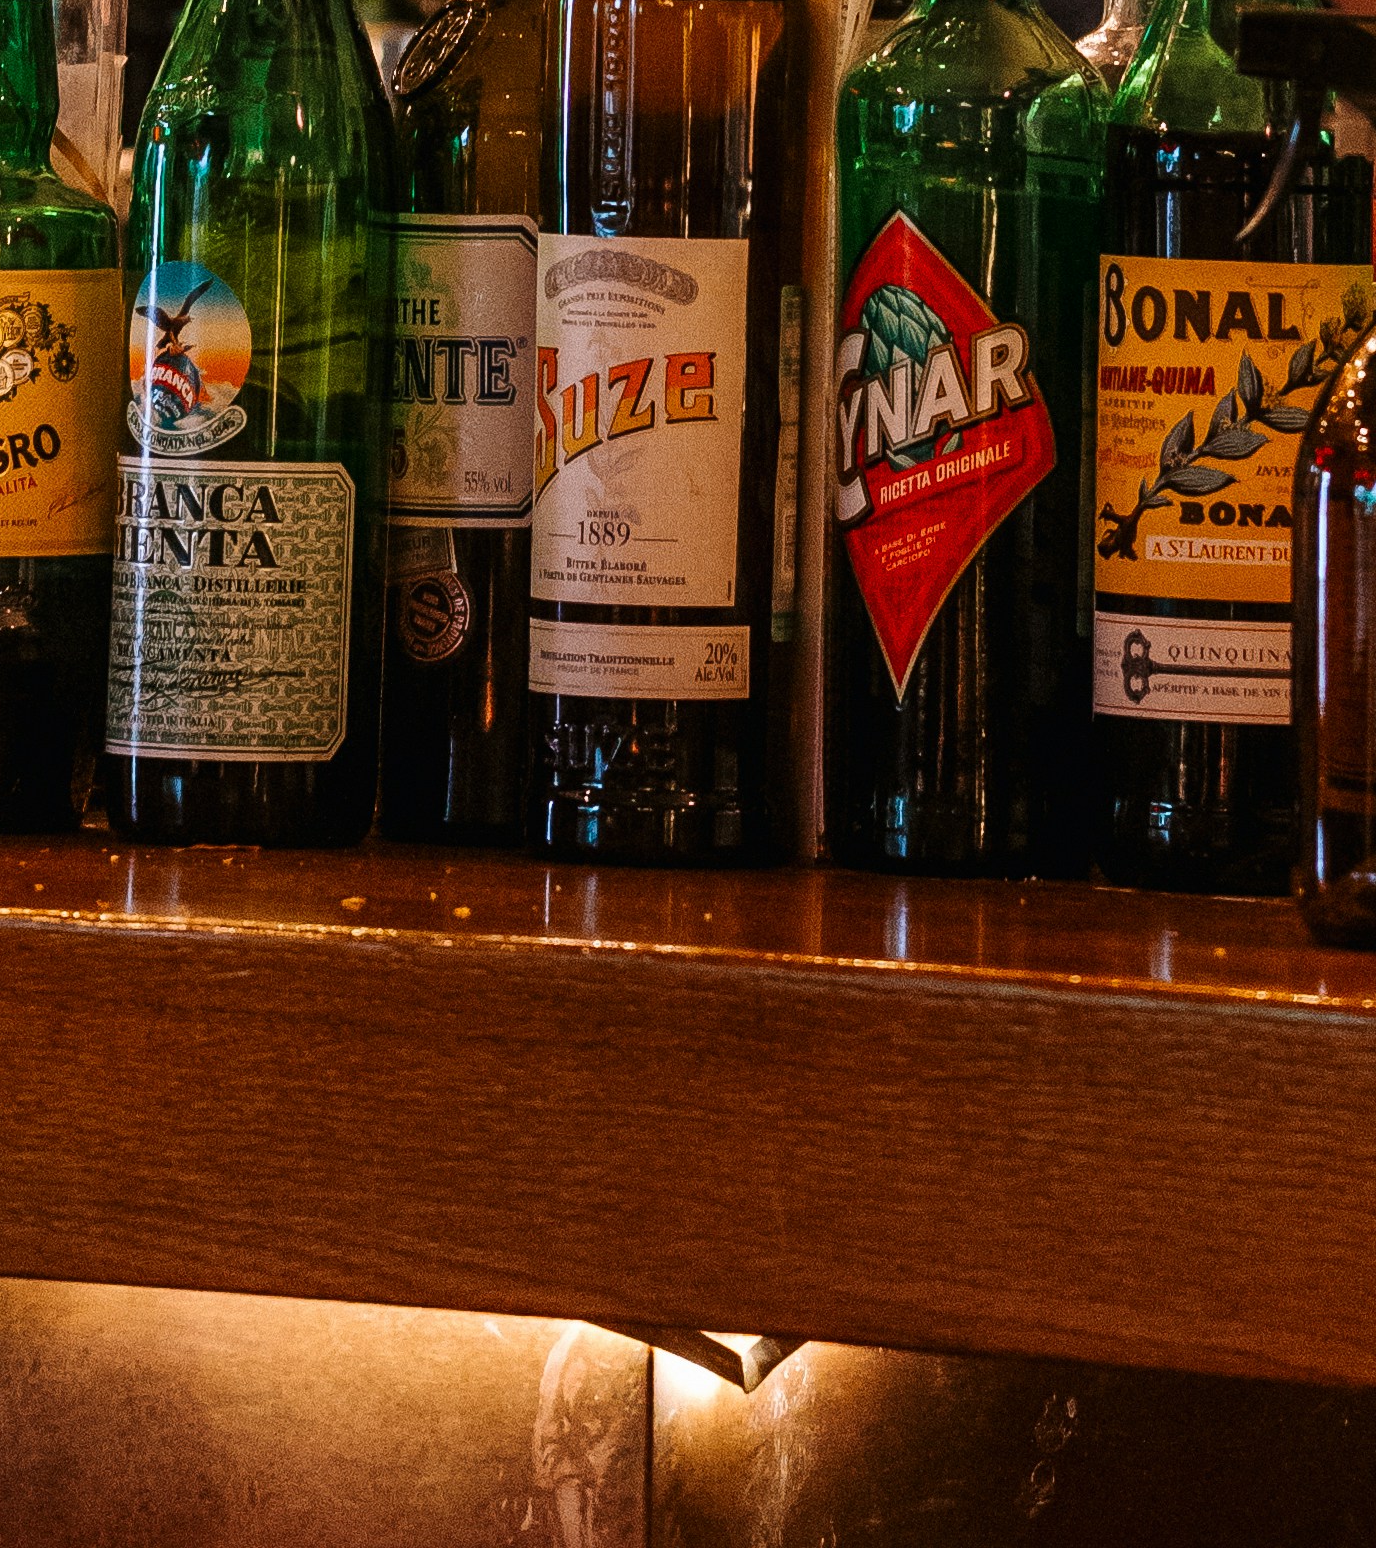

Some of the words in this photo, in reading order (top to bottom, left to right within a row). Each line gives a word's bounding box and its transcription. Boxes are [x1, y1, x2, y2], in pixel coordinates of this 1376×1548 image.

[1104, 262, 1303, 347] BONAL
[535, 346, 718, 507] Suze
[879, 469, 932, 505] RICETTA
[935, 440, 1012, 483] ORIGINALE
[577, 520, 632, 548] 1889
[193, 576, 308, 594] DISTILLERIE
[704, 642, 738, 665] 20%
